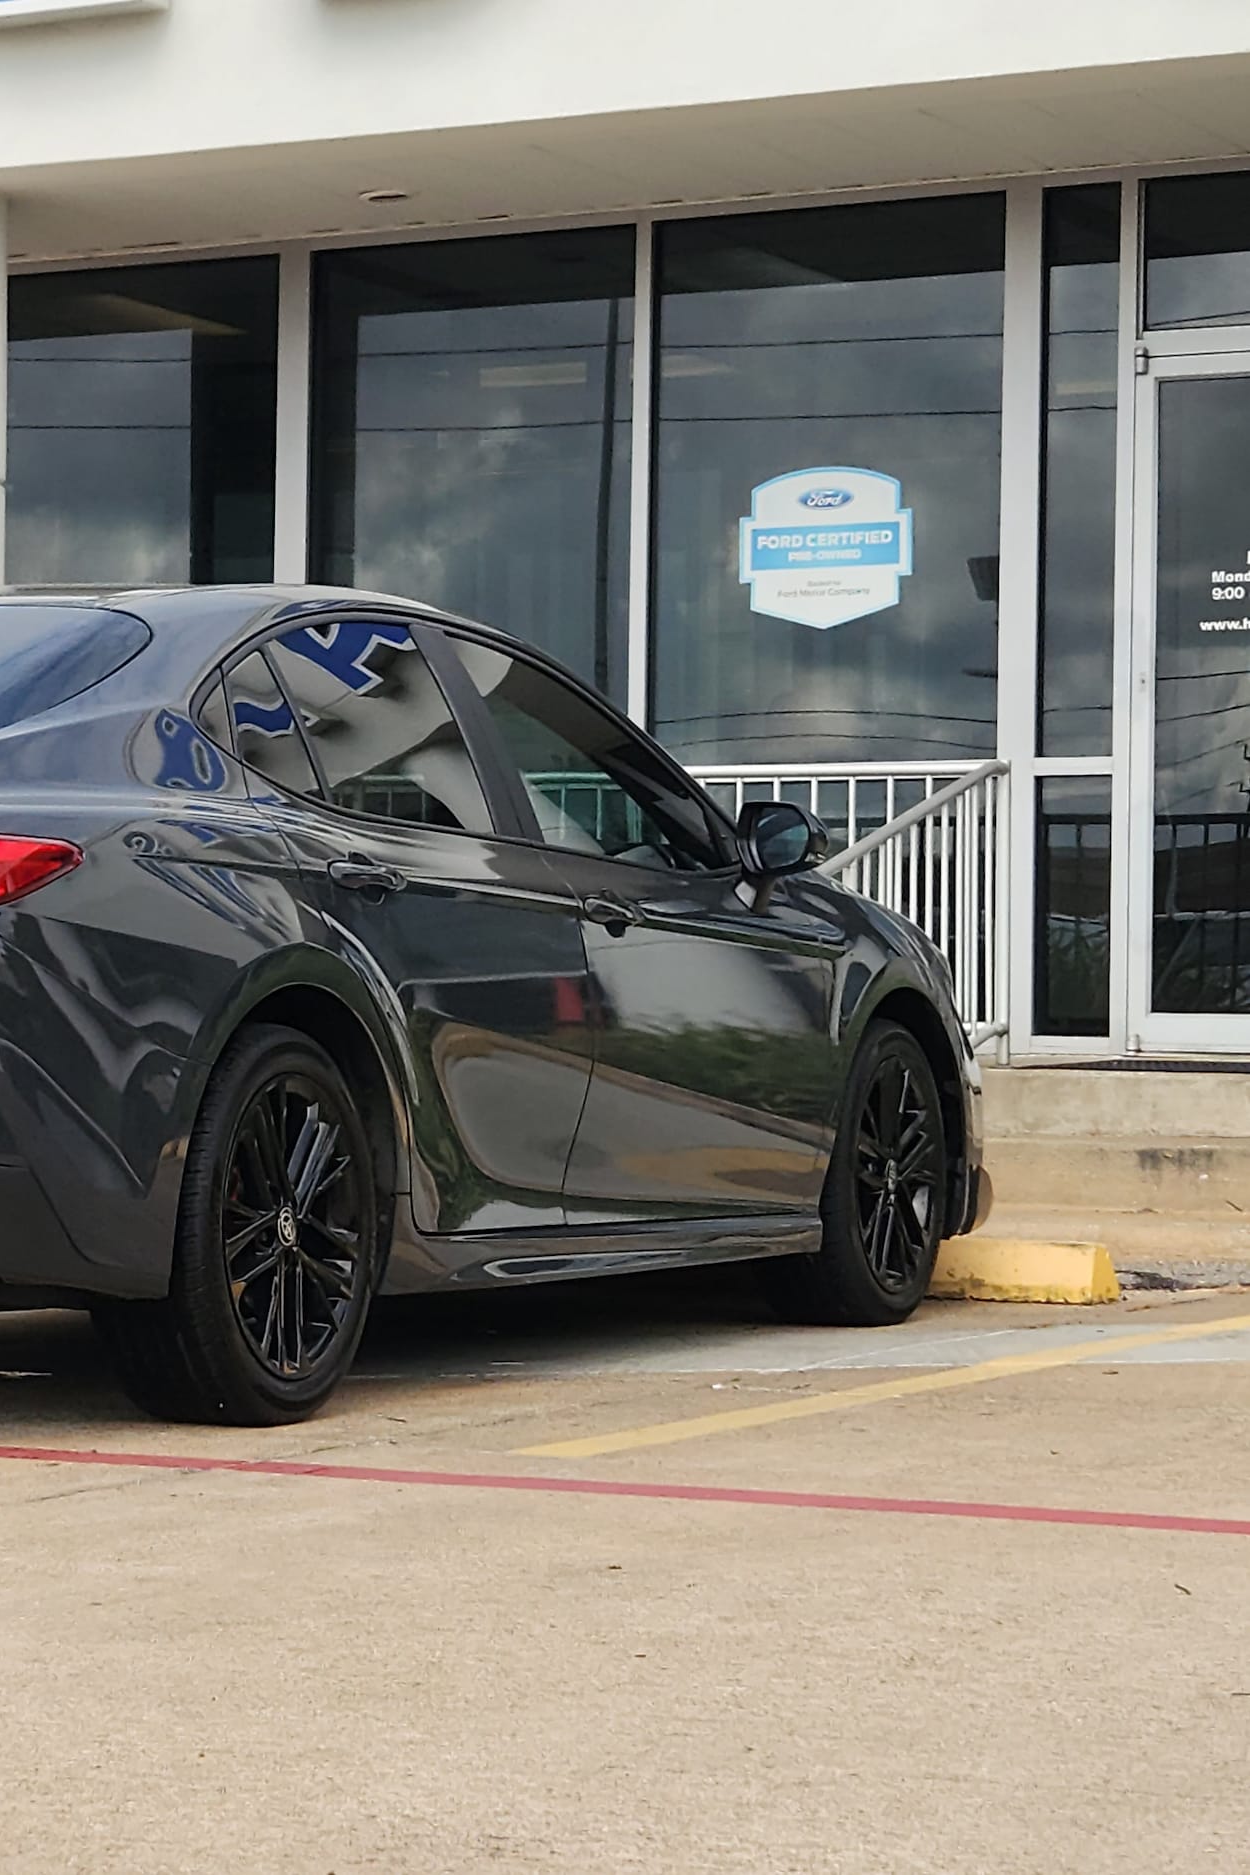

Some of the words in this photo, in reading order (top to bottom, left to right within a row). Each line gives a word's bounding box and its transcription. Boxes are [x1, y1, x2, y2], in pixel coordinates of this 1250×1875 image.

[807, 491, 843, 506] Ford
[756, 534, 803, 550] FORD
[806, 529, 893, 547] CERTIFIED
[1211, 586, 1245, 600] 9:00
